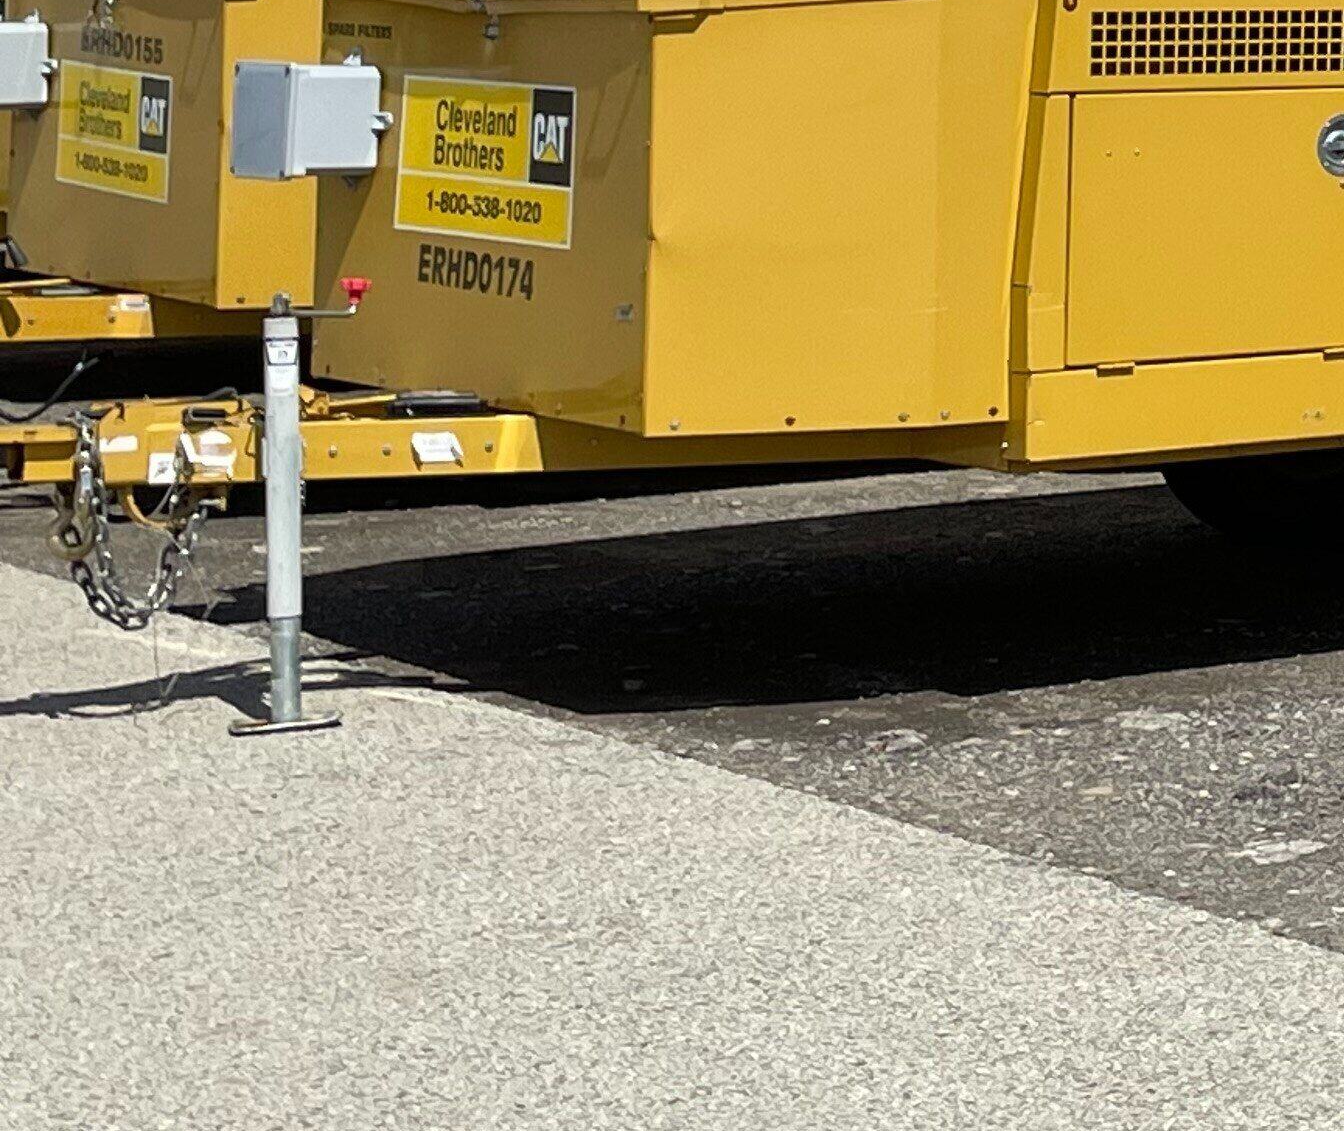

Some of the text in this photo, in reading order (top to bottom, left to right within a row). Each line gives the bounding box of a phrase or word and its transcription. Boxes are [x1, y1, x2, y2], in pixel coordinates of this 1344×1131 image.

[140, 95, 167, 137] CAT
[436, 99, 518, 139] Cleveland
[433, 134, 506, 173] Brothers
[532, 112, 571, 164] CAT
[426, 189, 543, 225] 1-800-538-1020
[417, 243, 535, 302] ERHD0174
